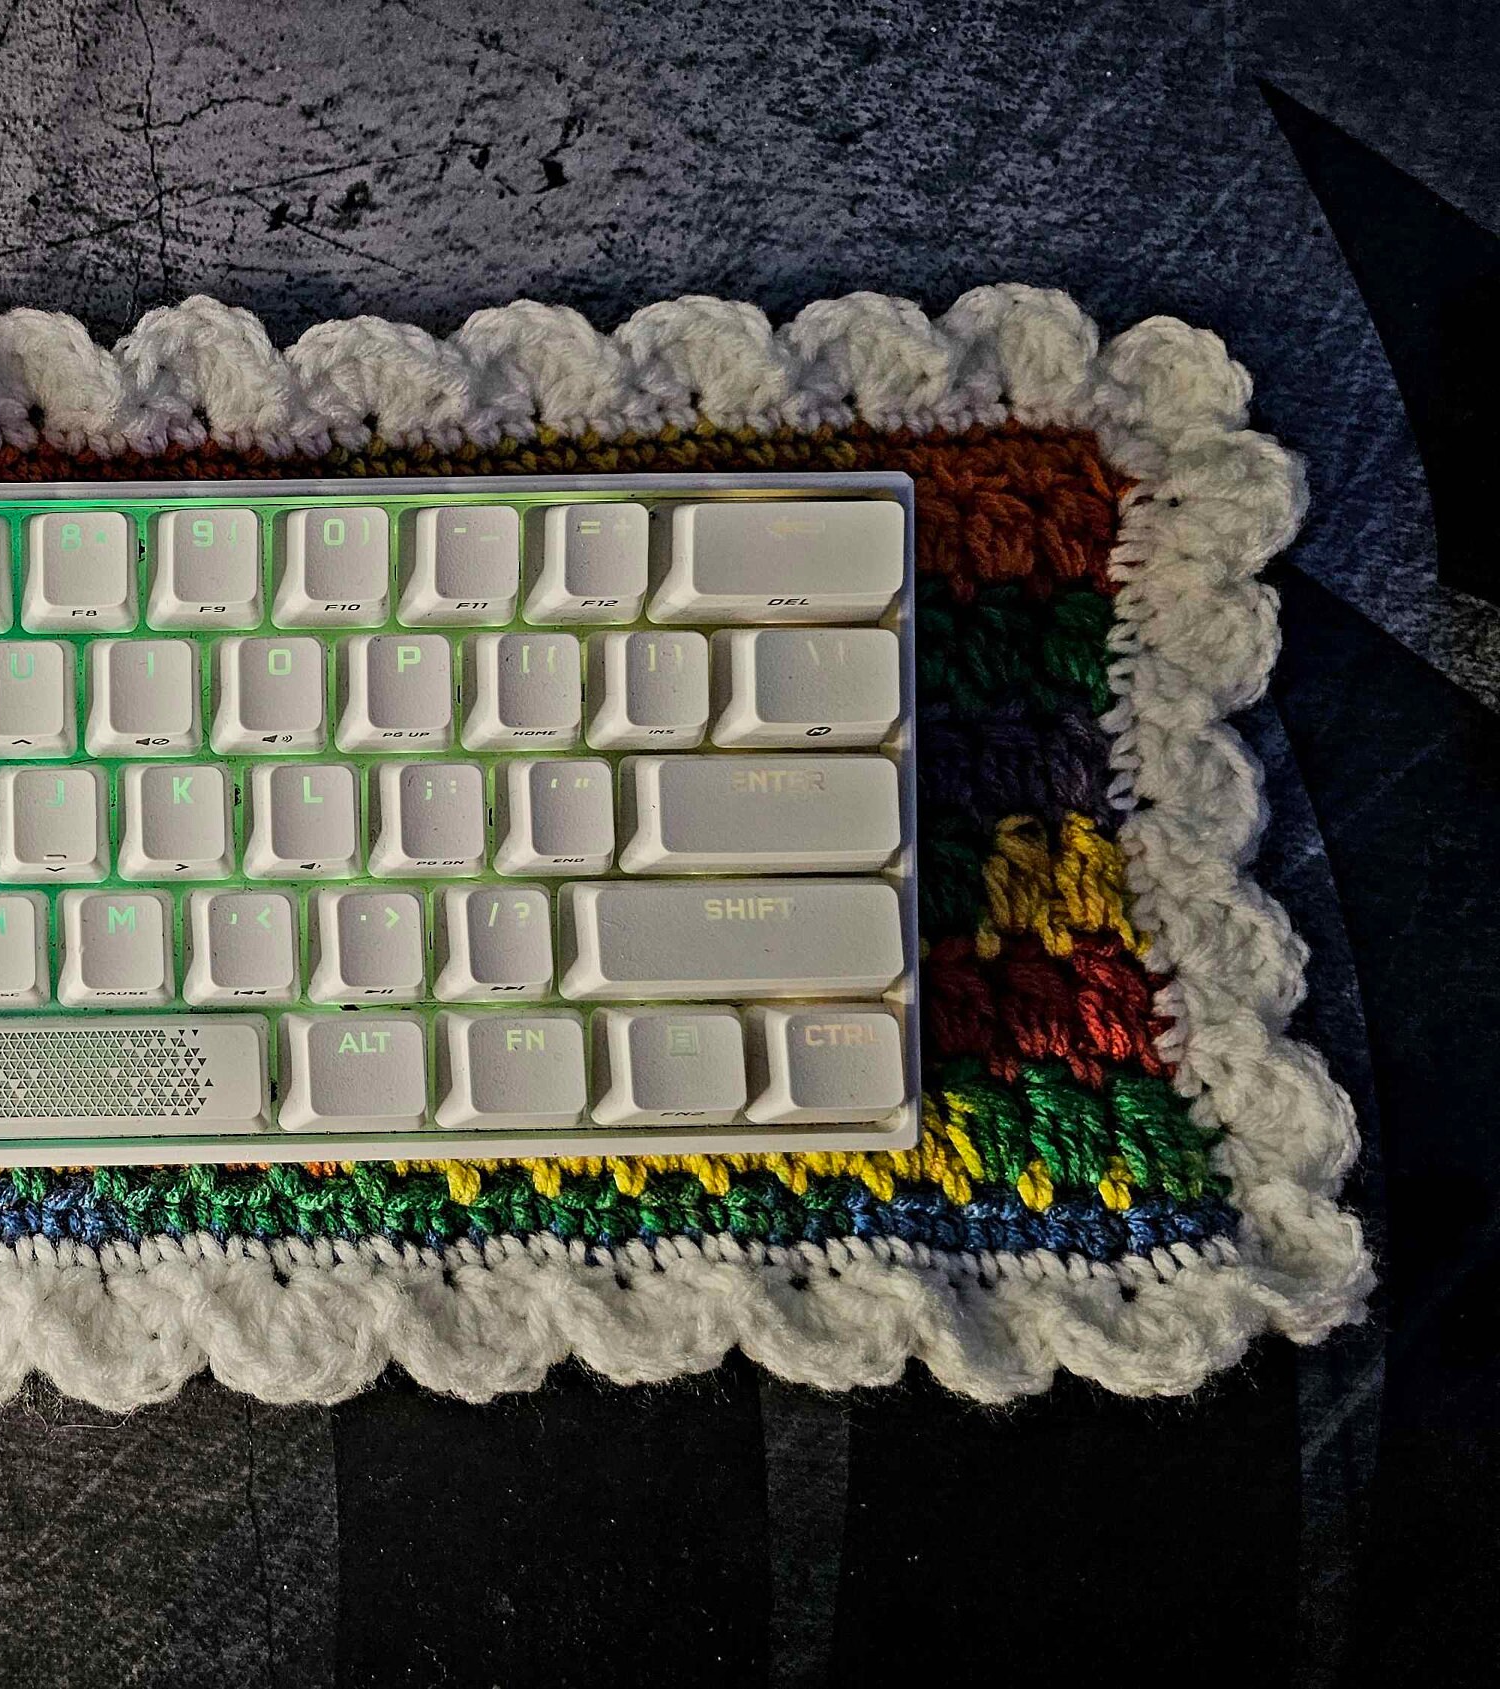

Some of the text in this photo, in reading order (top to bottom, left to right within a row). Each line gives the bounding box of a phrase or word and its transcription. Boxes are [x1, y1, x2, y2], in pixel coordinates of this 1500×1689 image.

[71, 609, 98, 617] F8
[199, 605, 226, 614] F9
[324, 603, 362, 612] F10
[455, 602, 489, 610] F11
[581, 599, 619, 608] F12
[767, 597, 811, 607] DEL
[11, 653, 34, 681] U
[267, 648, 292, 676] O
[397, 646, 422, 673] P
[172, 776, 194, 804] K
[302, 776, 324, 804] L
[730, 769, 828, 793] ENTER
[47, 780, 65, 808] J
[108, 906, 137, 934] M
[704, 897, 797, 921] SHIFT
[338, 1030, 392, 1054] ALT
[506, 1029, 546, 1051] FN
[804, 1024, 880, 1047] CTRL
